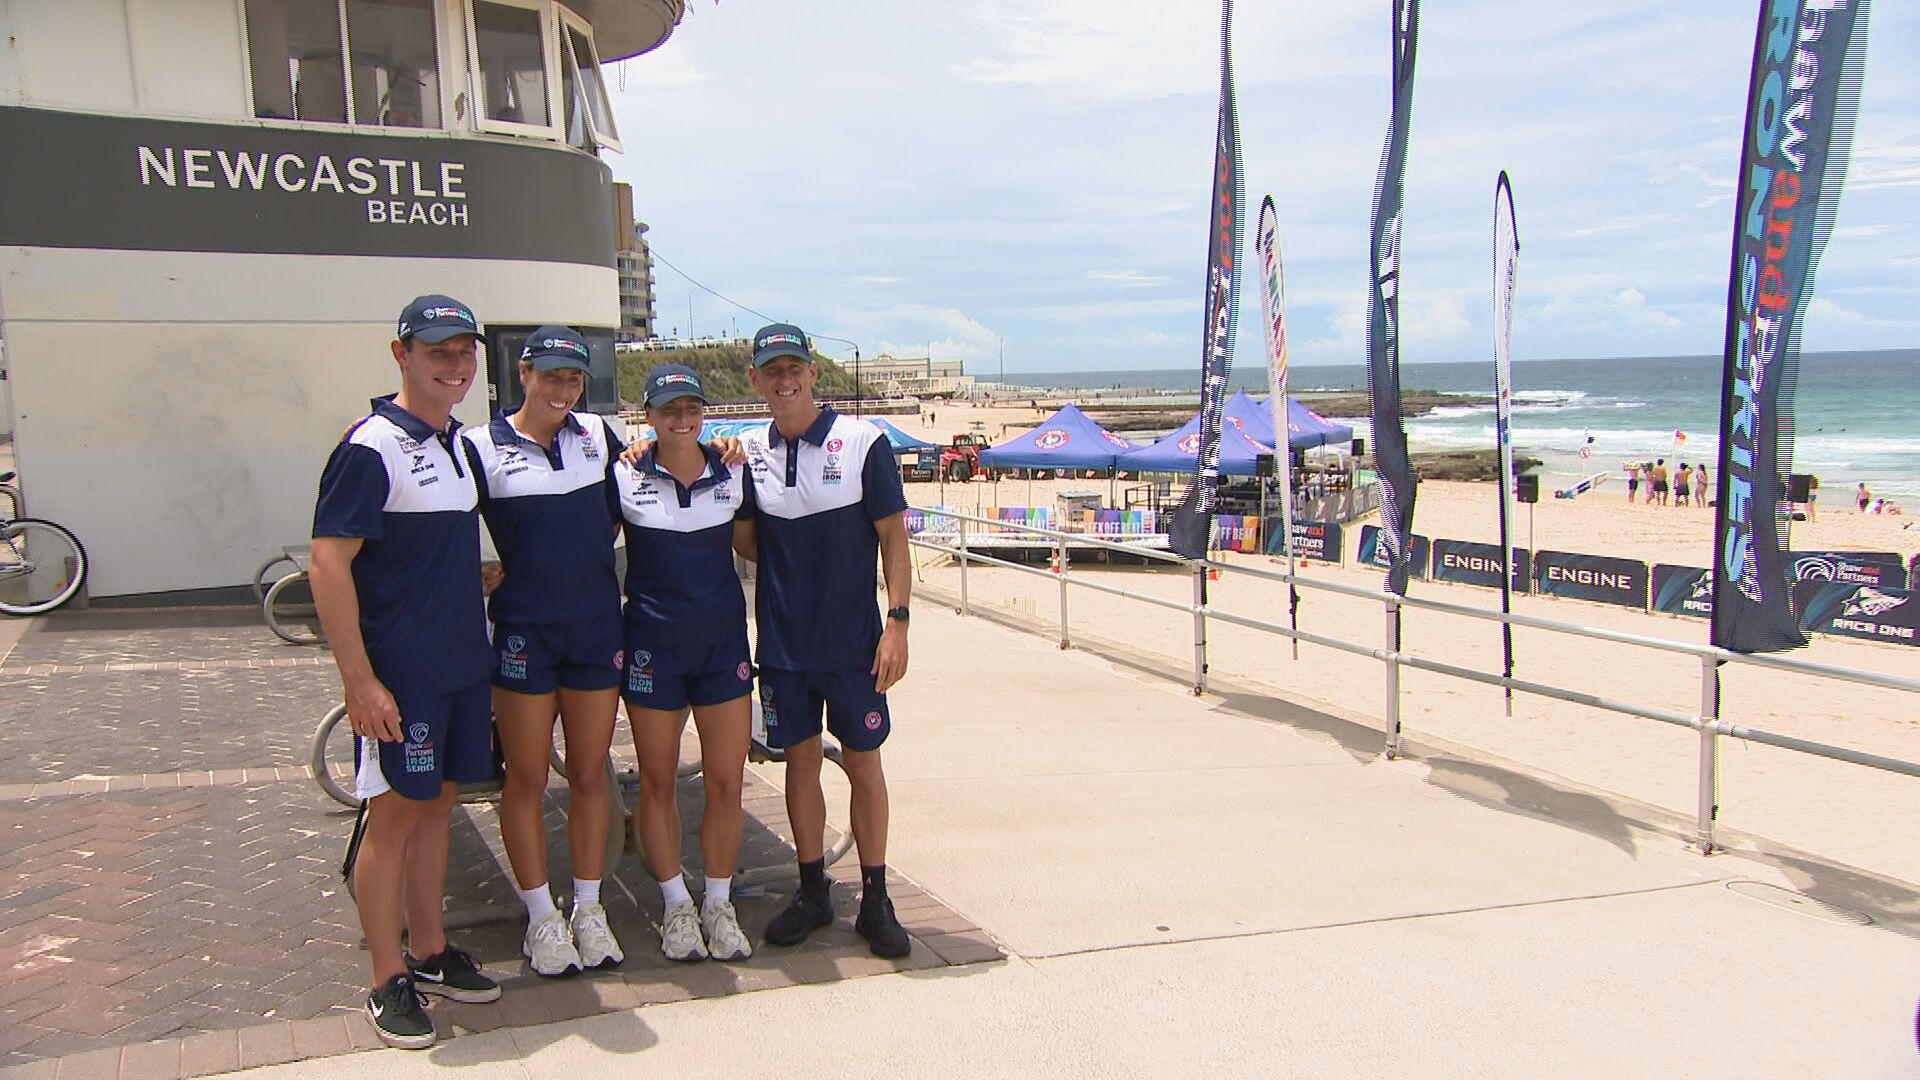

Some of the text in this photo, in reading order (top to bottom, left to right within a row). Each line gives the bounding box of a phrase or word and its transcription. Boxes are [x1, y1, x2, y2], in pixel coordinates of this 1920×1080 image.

[137, 146, 467, 198] NEWCASTLE
[366, 200, 469, 226] BEACH
[1759, 169, 1802, 312] and
[1723, 252, 1760, 582] SERIES
[1291, 536, 1324, 549] rtners
[1548, 566, 1632, 590] ENGINE
[1838, 572, 1880, 584] Partners
[1682, 600, 1712, 612] RAC
[1832, 618, 1915, 638] RACE ONE
[405, 756, 434, 766] IRON
[406, 764, 435, 772] SERIES
